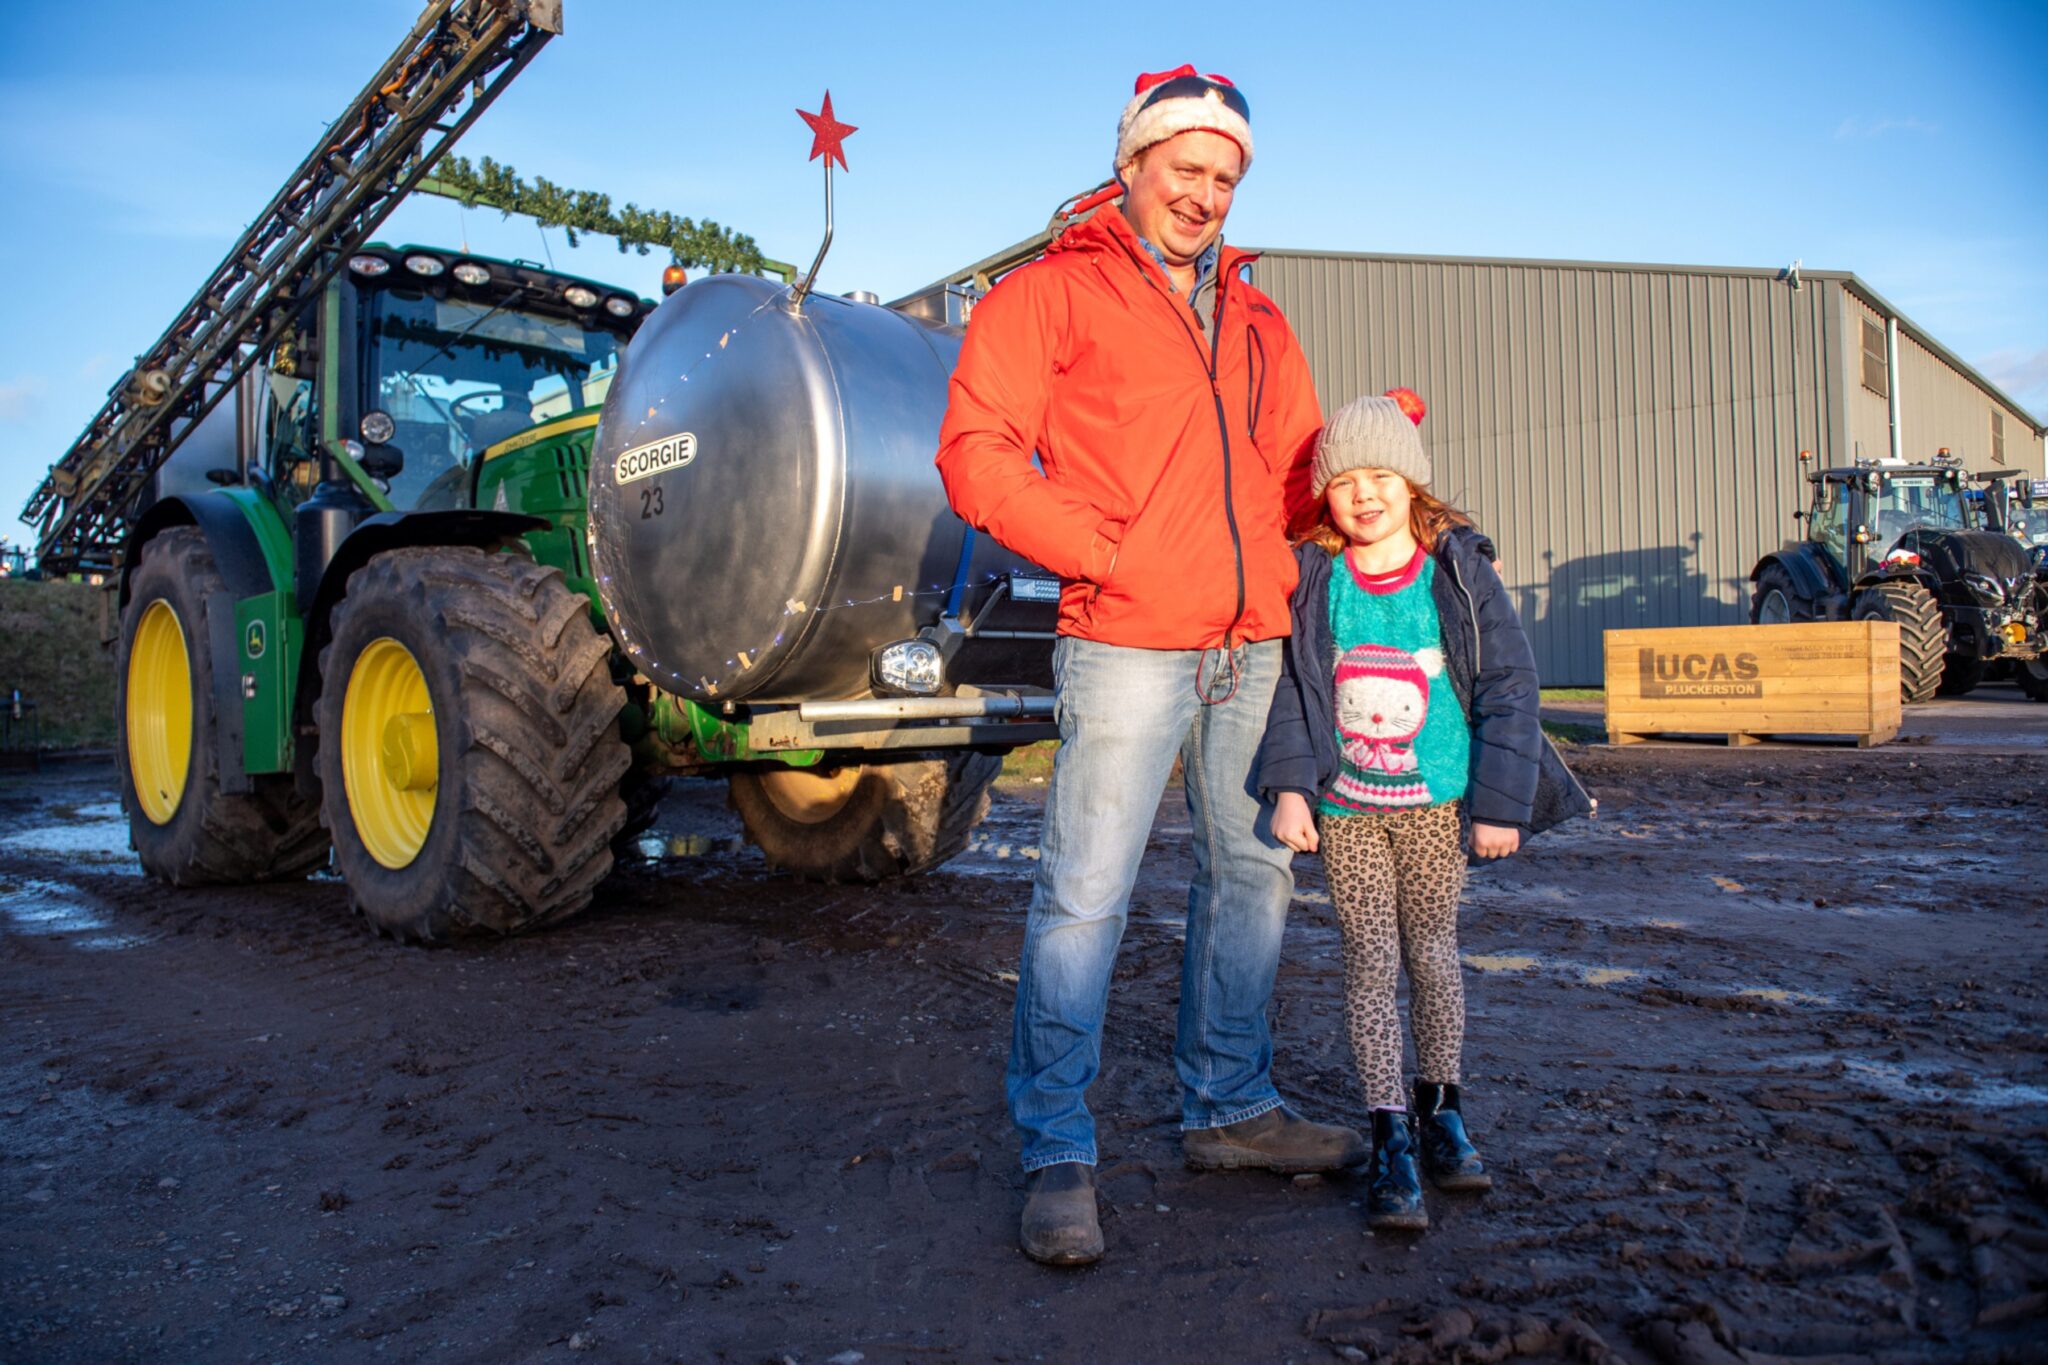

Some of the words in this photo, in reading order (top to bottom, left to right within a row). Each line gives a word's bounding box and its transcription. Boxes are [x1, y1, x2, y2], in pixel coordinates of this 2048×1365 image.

[619, 439, 689, 479] SCORGIE
[640, 486, 664, 519] 23
[1639, 647, 1760, 698] LUCAS
[1665, 684, 1755, 696] PLUCKERSTON
